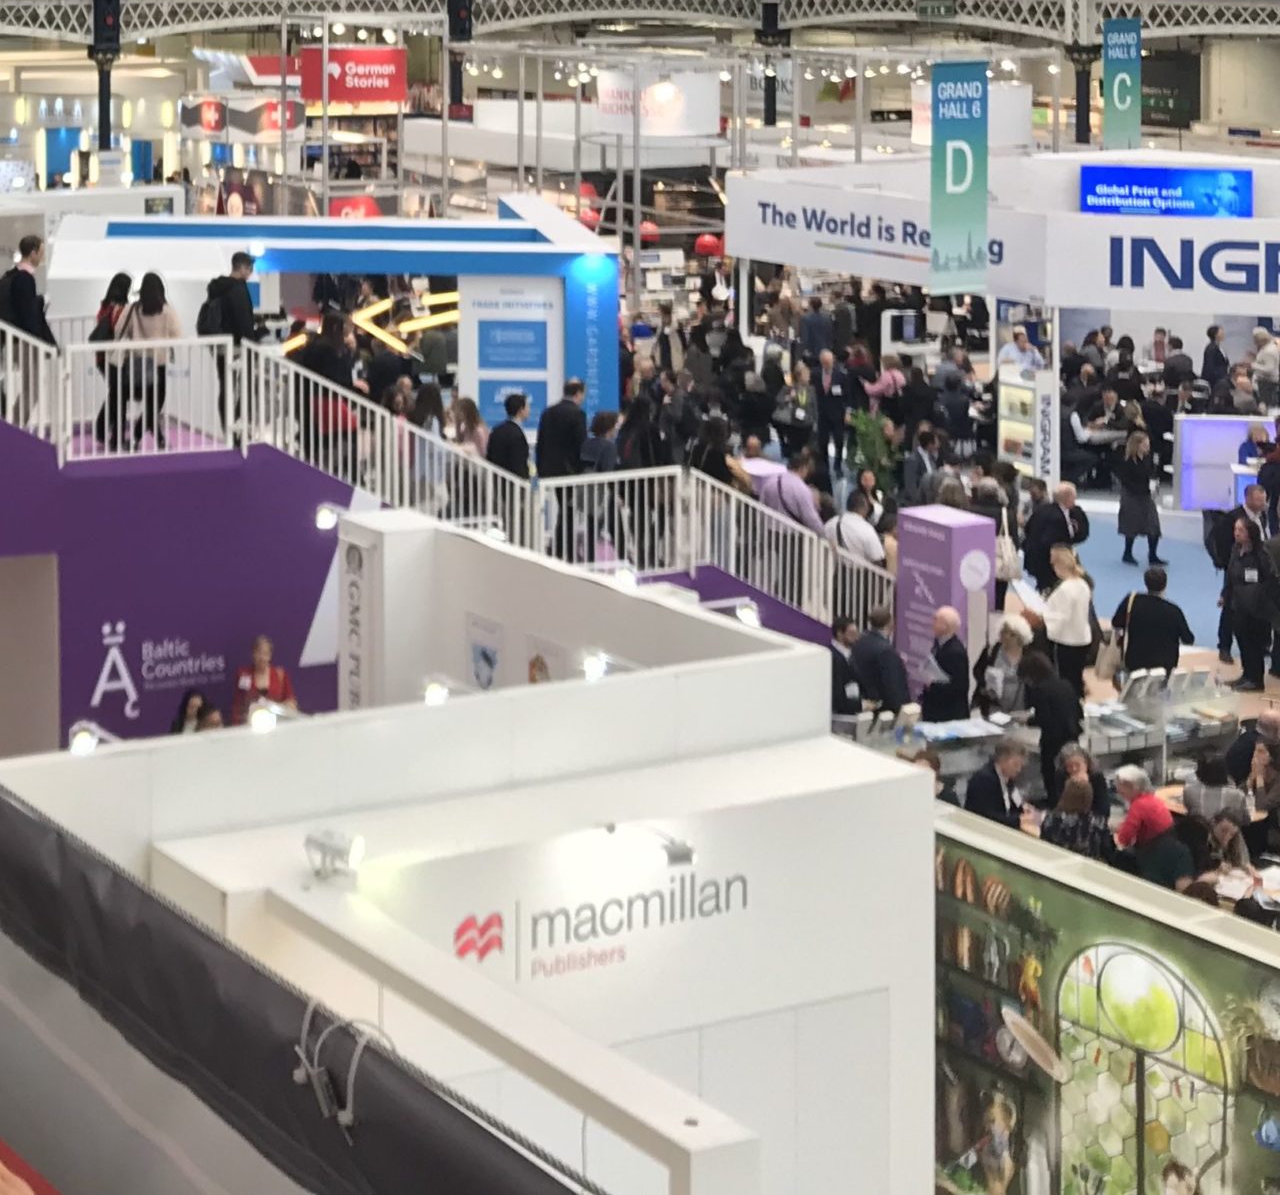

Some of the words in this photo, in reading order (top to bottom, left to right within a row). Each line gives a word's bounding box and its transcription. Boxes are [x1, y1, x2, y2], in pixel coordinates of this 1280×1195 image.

[1107, 32, 1137, 46] GRAND
[1108, 47, 1128, 59] HALL
[345, 62, 396, 75] German
[345, 75, 390, 88] Stories
[938, 81, 982, 100] GRAND
[1113, 72, 1131, 111] C
[939, 101, 969, 119] HALL
[972, 100, 981, 118] 6
[946, 139, 973, 194] D
[1096, 184, 1129, 196] Global
[1132, 185, 1158, 196] Print
[1161, 186, 1182, 197] and
[1087, 195, 1150, 208] Distribution
[1153, 197, 1195, 210] Options
[758, 202, 796, 229] The
[802, 208, 871, 239] World
[877, 216, 895, 243] is
[1040, 393, 1051, 477] INGRAM
[142, 638, 190, 662] Baltic
[141, 654, 225, 680] Countries
[531, 873, 748, 951] macmillan
[531, 945, 626, 980] Publishers
